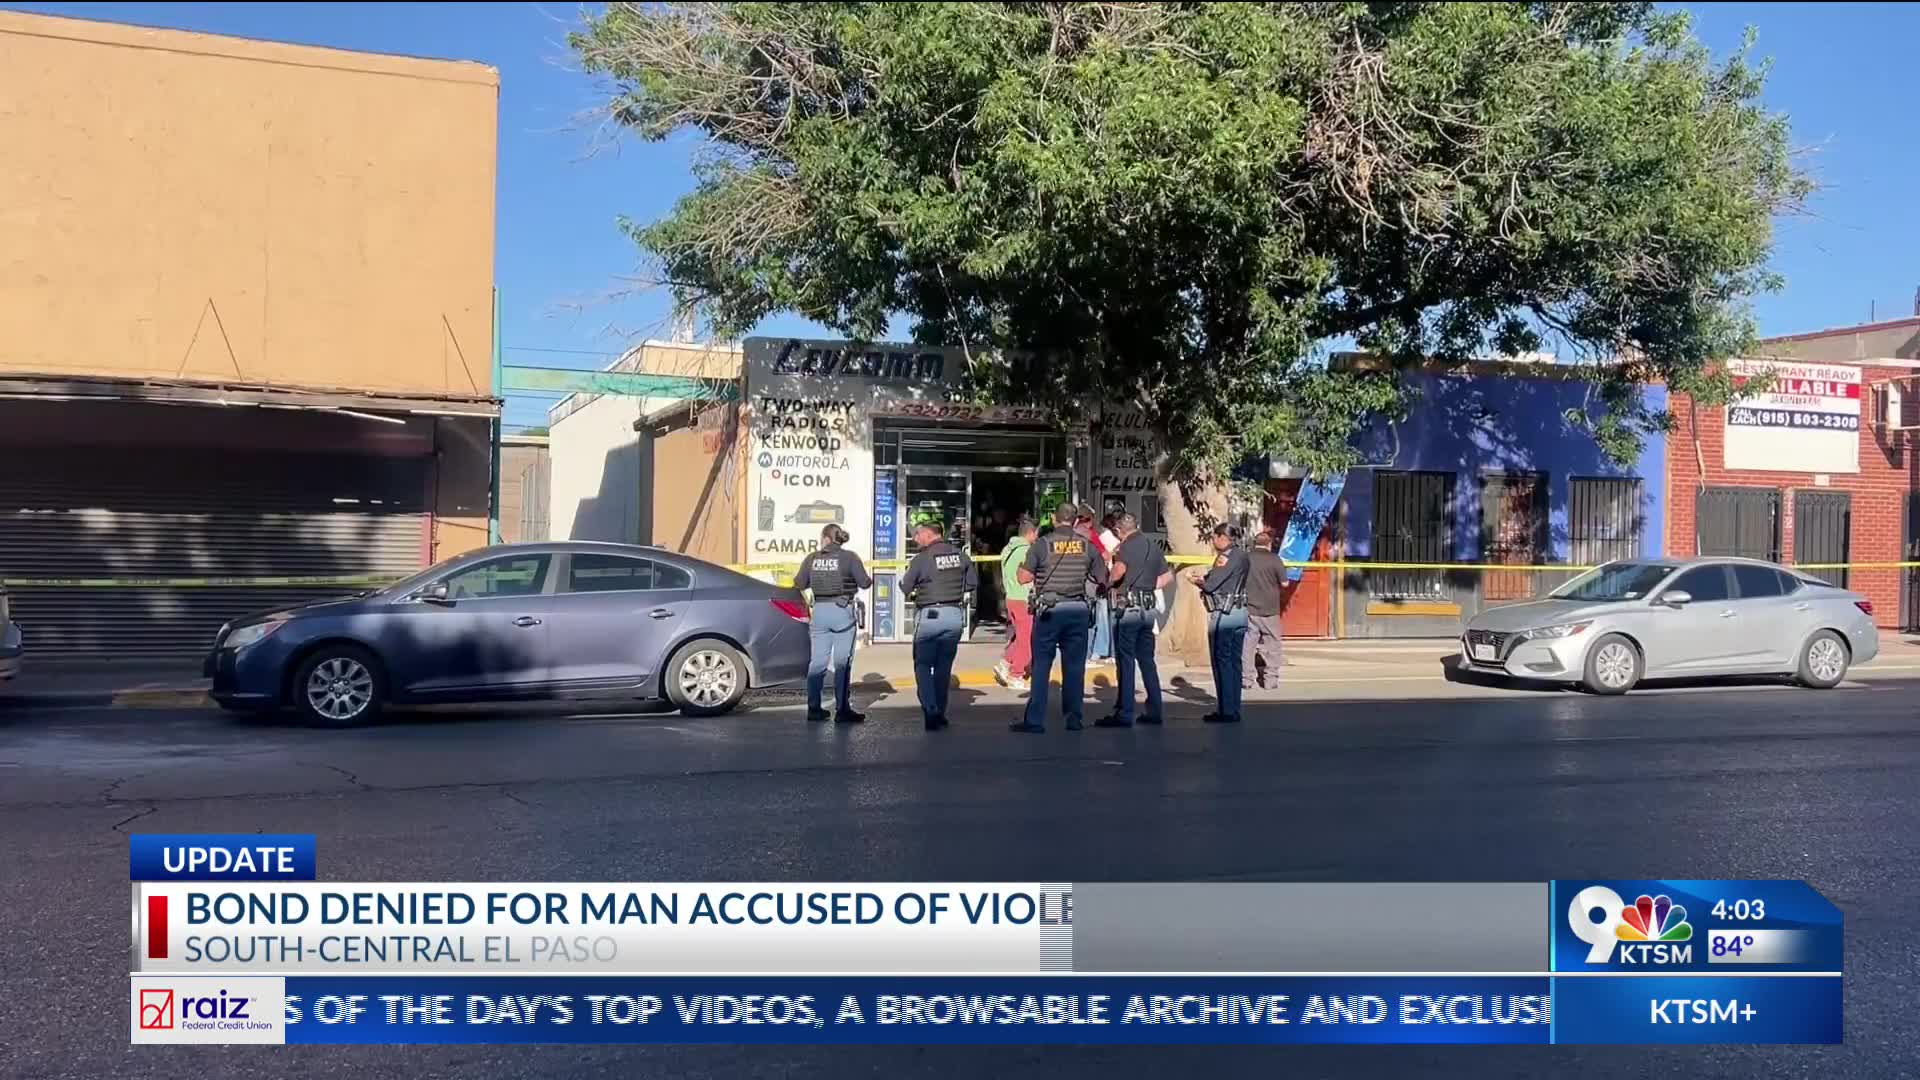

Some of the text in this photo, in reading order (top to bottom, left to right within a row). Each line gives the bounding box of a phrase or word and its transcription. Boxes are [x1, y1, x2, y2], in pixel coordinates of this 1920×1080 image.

[1817, 368, 1856, 380] READY
[761, 397, 855, 414] TWO-WAY
[1734, 408, 1752, 416] CALL
[771, 416, 844, 430] RADIOS
[1731, 415, 1757, 425] ZACH
[1757, 410, 1790, 426] (915)
[761, 434, 841, 451] KENWOOD
[775, 455, 850, 470] MOTOROLA
[783, 473, 831, 487] ICOM
[1054, 540, 1083, 549] POLICE
[812, 559, 839, 568] POLICE
[936, 554, 961, 565] POLICE
